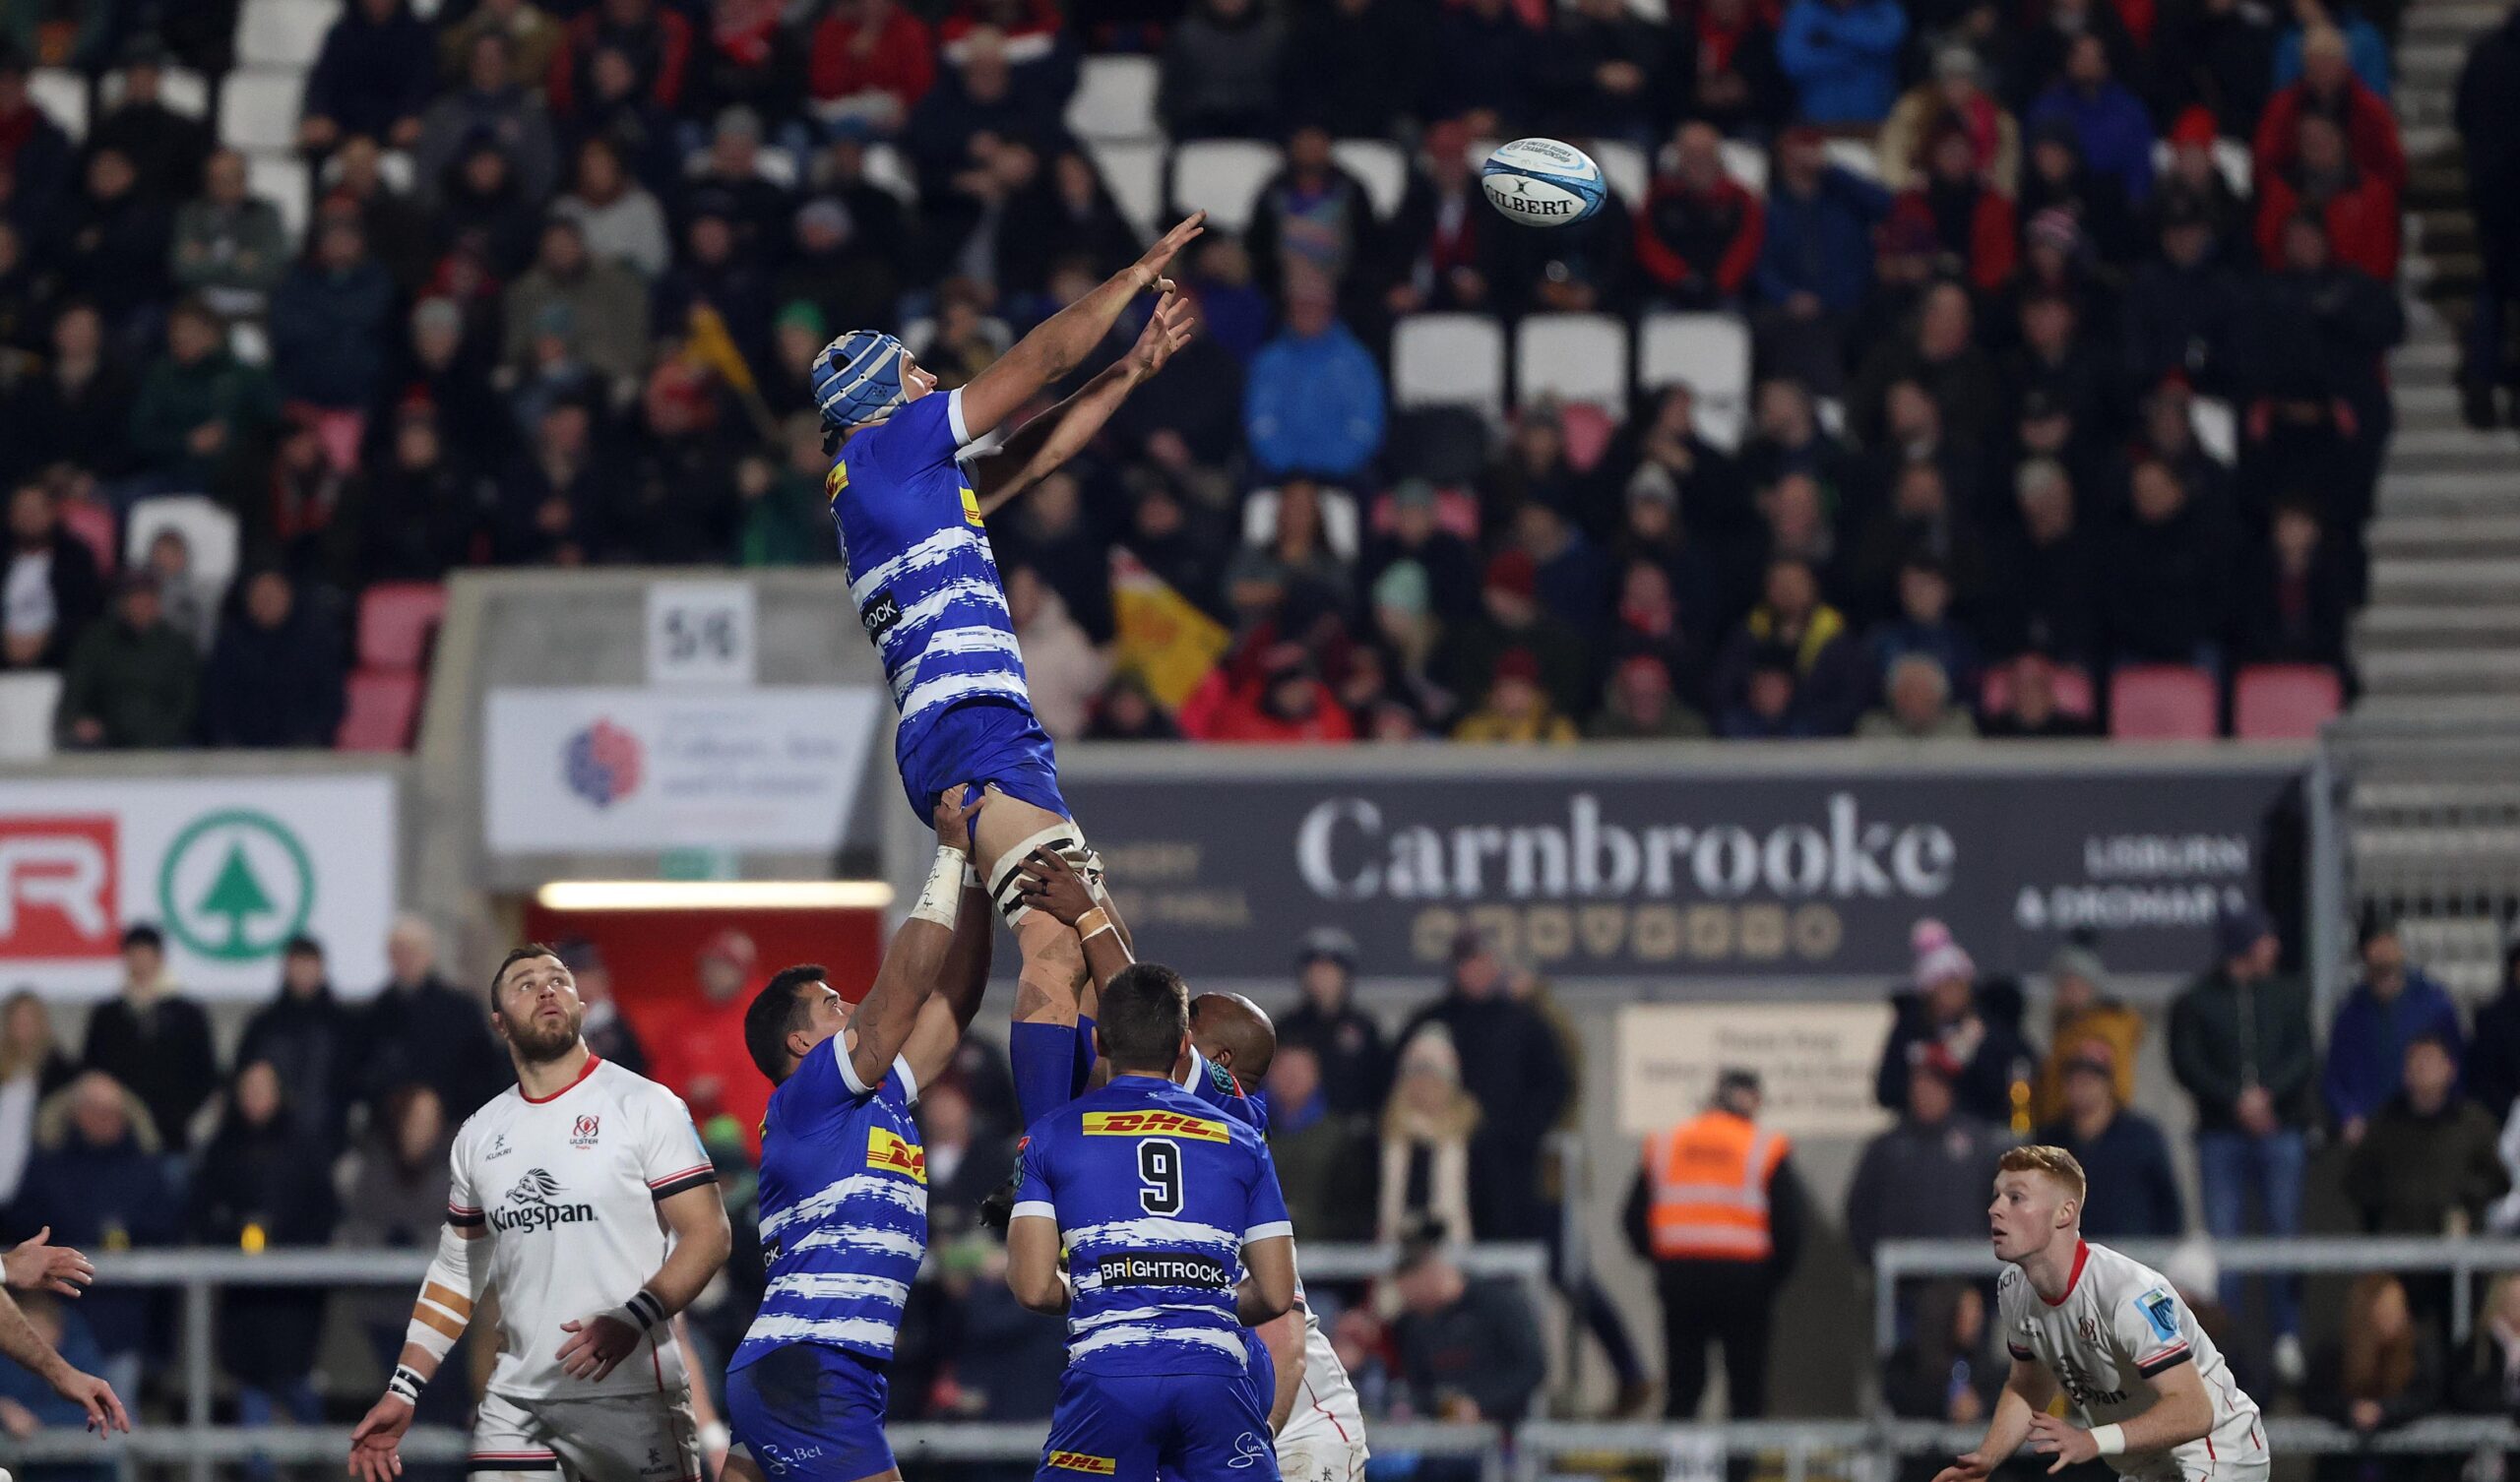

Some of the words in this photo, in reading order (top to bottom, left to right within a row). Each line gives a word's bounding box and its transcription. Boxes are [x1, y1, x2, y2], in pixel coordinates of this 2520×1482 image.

[1521, 145, 1571, 163] CHAMPIONSHIP
[1295, 793, 1957, 898] Carnbrooke
[1104, 1113, 1211, 1137] DHL
[484, 1147, 513, 1162] KUKRI
[1137, 1138, 1183, 1217] 9
[489, 1204, 594, 1234] Kingspan
[1053, 1453, 1103, 1471] DHL
